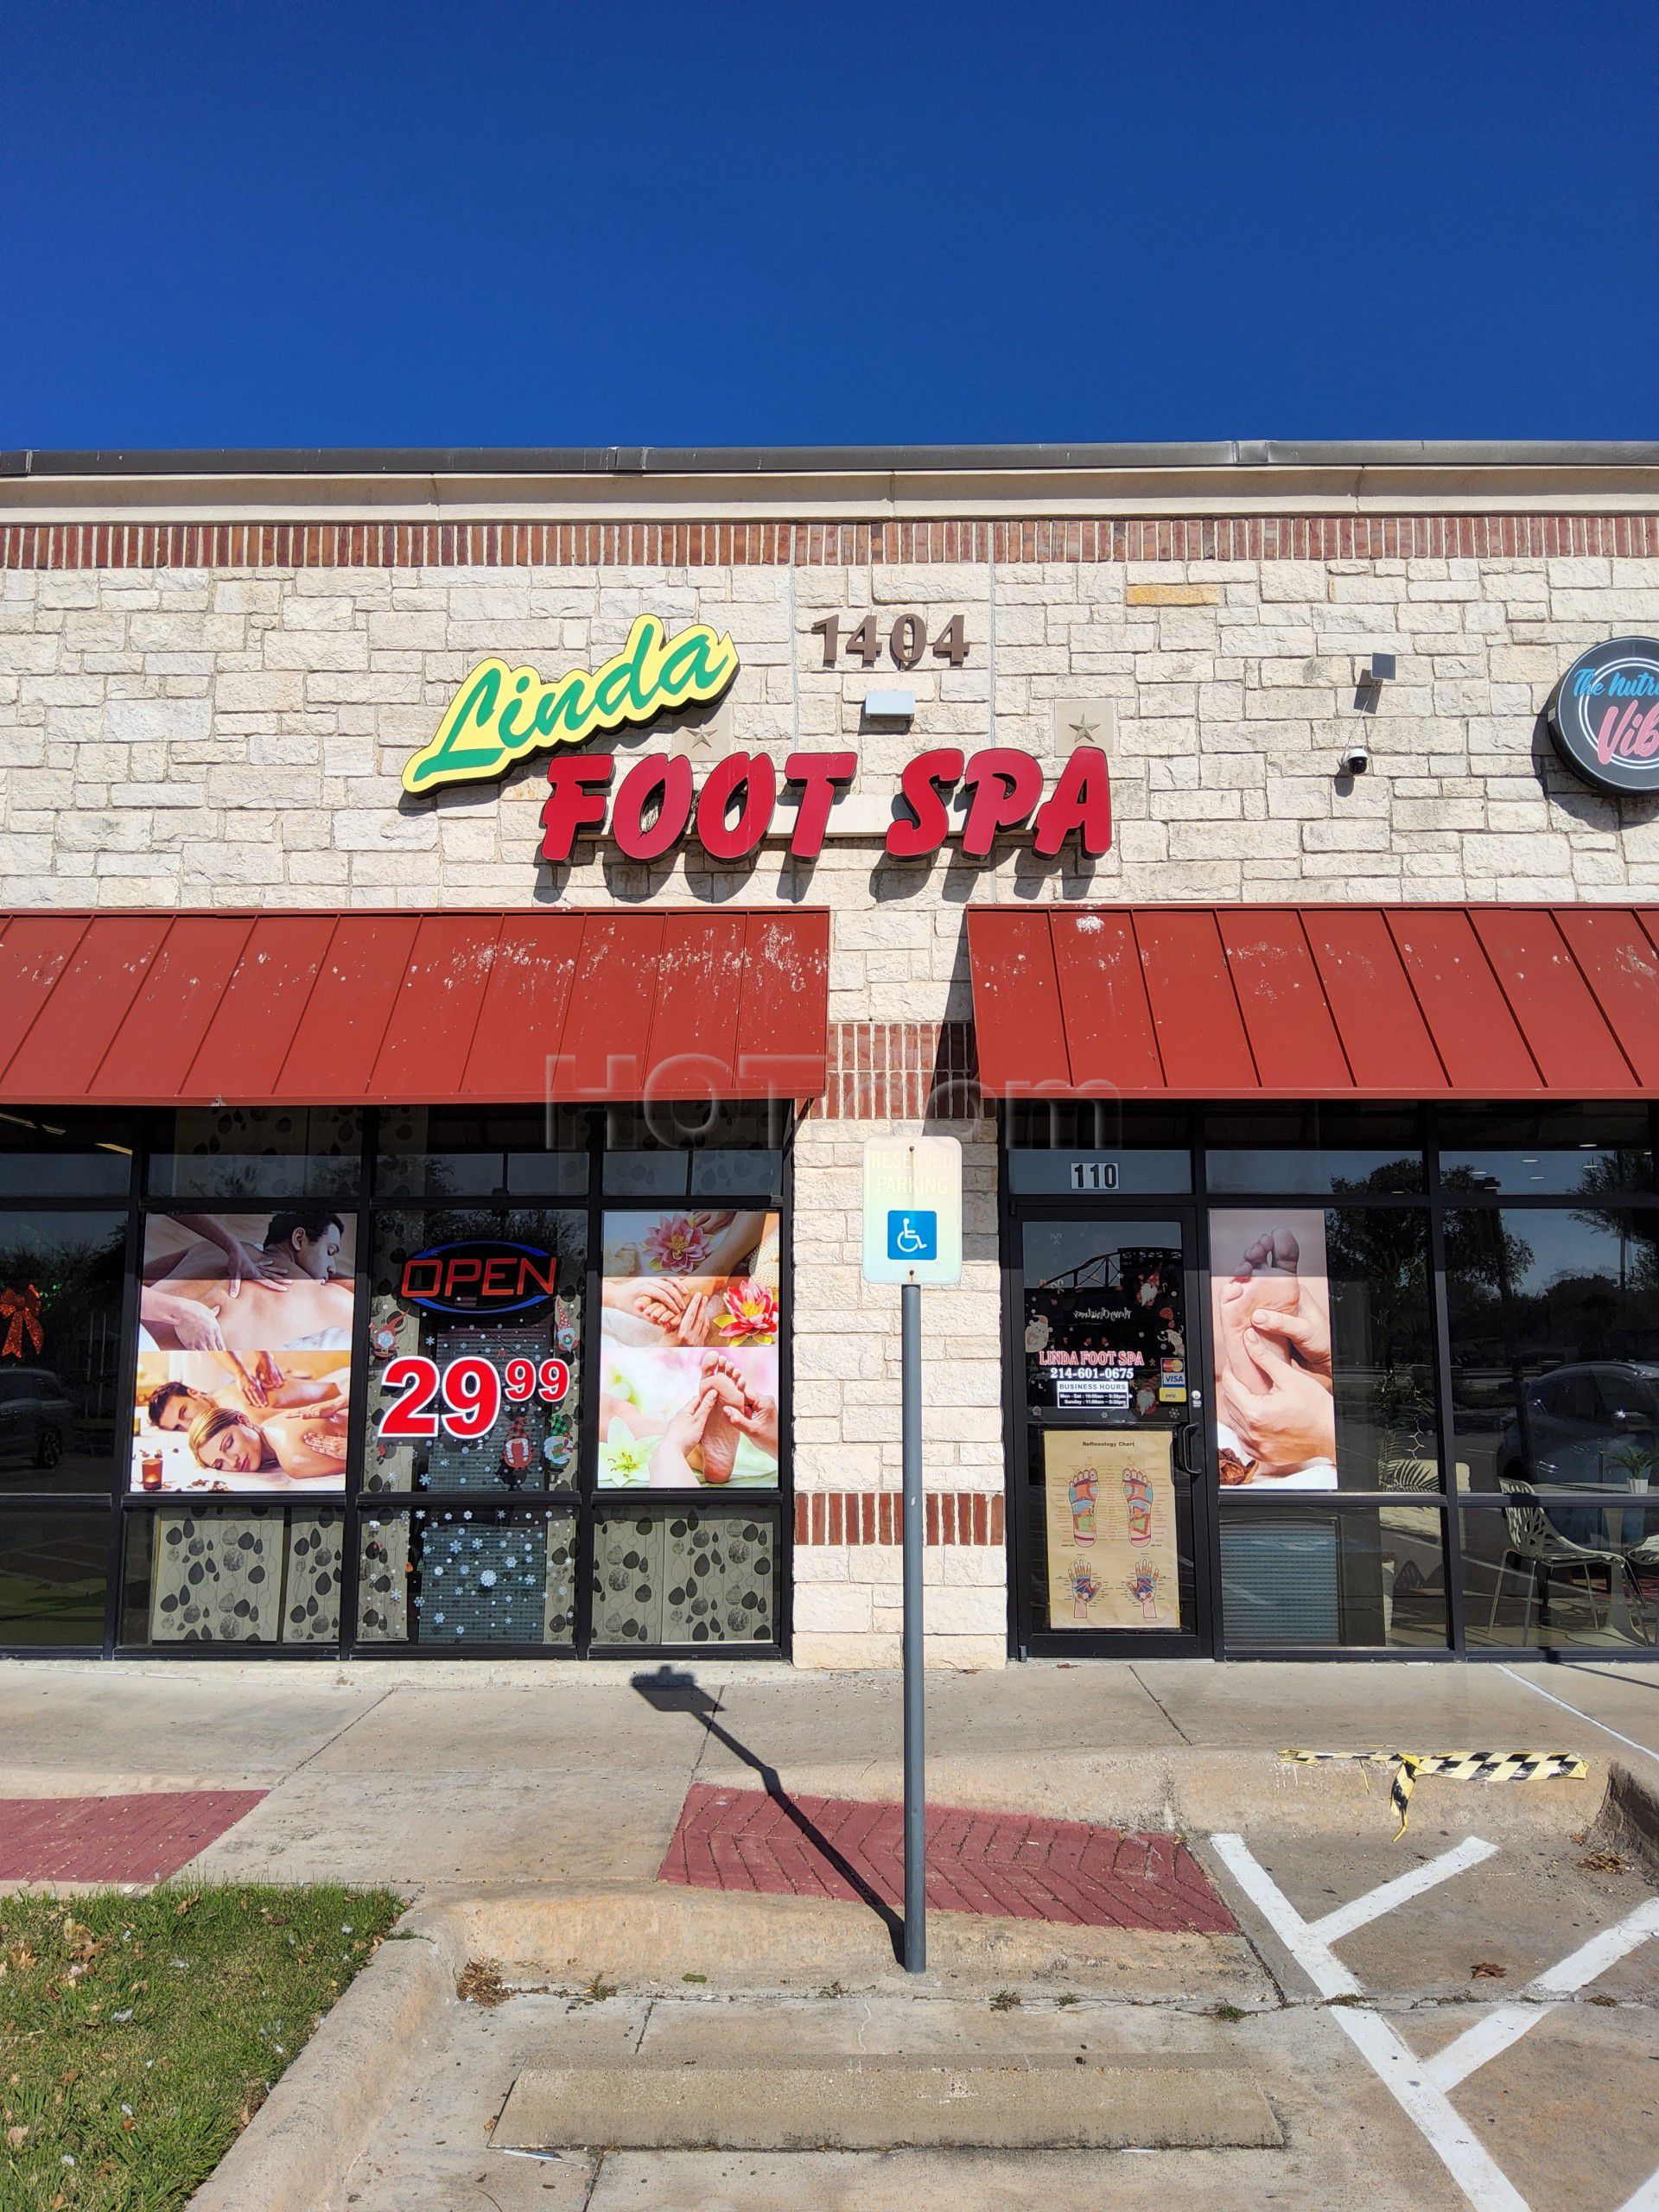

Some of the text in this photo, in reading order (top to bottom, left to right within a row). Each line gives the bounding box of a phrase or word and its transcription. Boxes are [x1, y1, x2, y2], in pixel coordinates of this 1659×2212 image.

[813, 614, 970, 666] 1404
[1573, 668, 1605, 697] The
[410, 617, 734, 785] Linda
[541, 746, 1113, 864] FOOT SPA
[871, 1151, 955, 1170] RESERVED
[877, 1175, 948, 1195] PARKING
[1074, 1164, 1117, 1188] 110
[400, 1257, 557, 1298] OPEN
[1039, 1351, 1145, 1366] LINDA FOOT SPA
[1050, 1368, 1135, 1380] 214-601-0675
